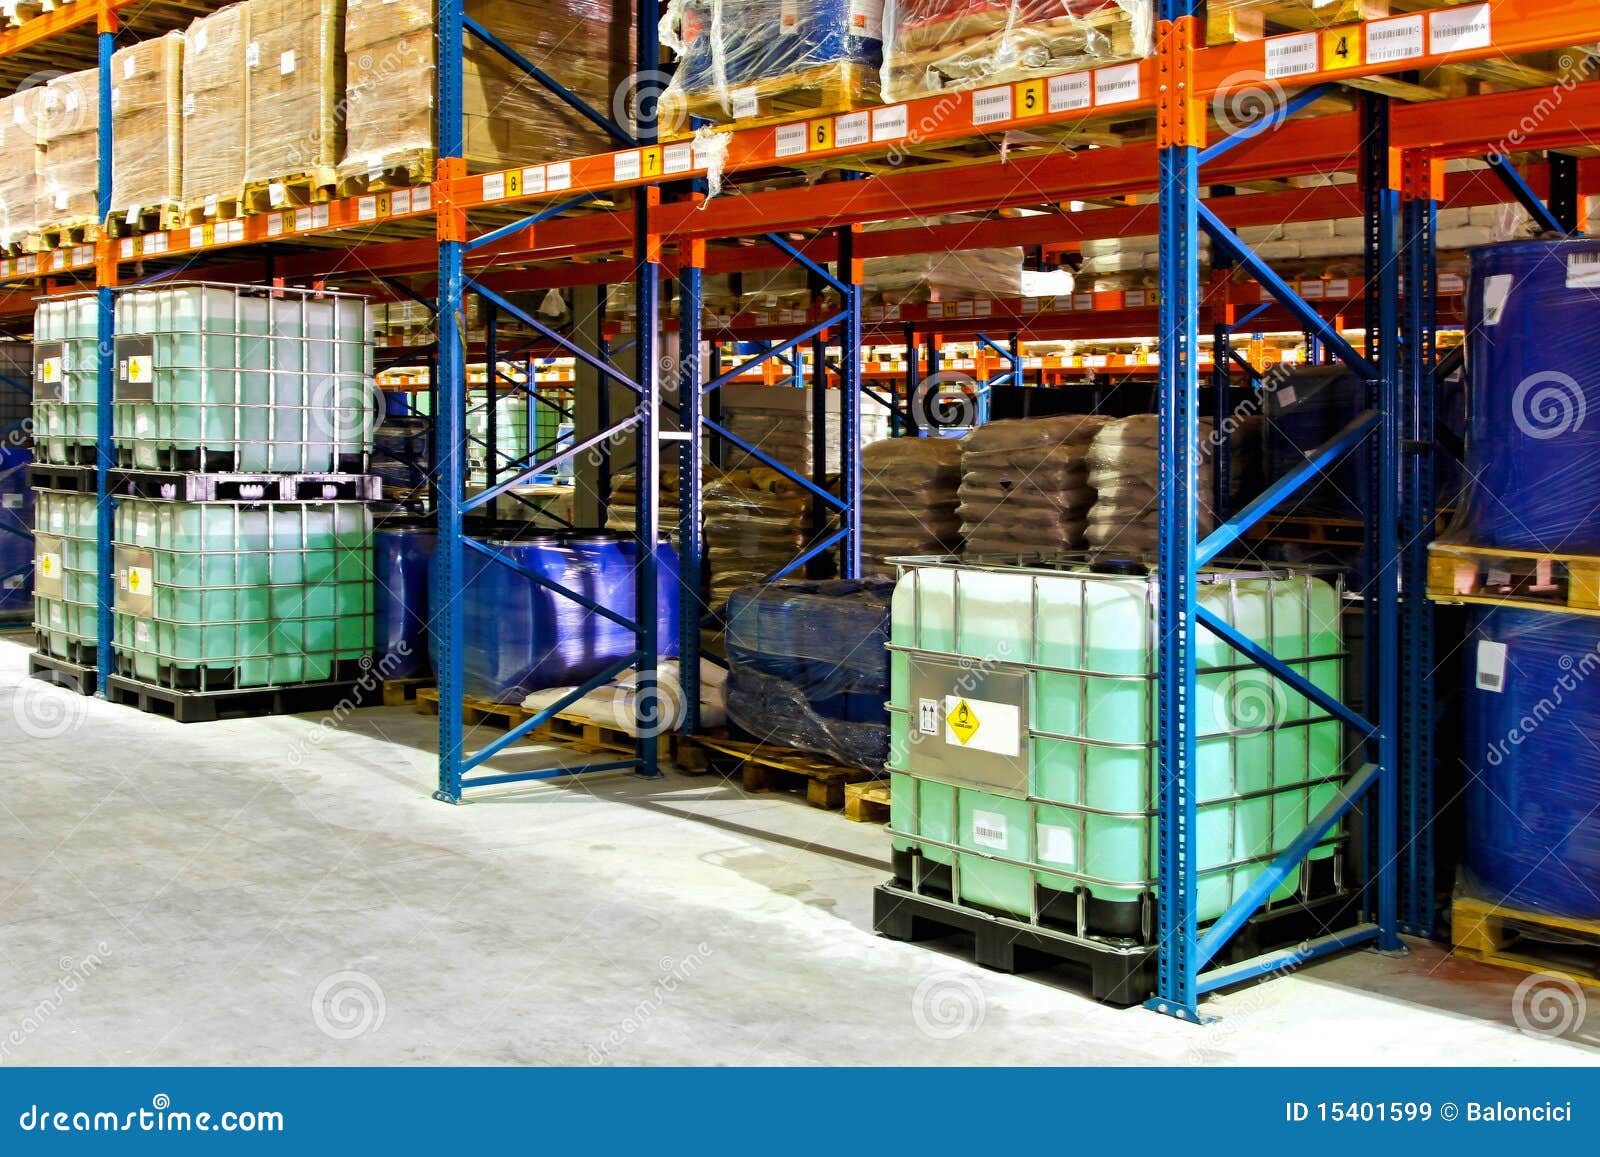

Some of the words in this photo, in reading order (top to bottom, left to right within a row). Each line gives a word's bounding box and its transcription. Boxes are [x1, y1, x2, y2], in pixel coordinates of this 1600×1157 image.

[1335, 36, 1348, 59] 4
[1025, 88, 1036, 109] 5
[816, 125, 825, 143] 6
[648, 154, 655, 170] 7
[510, 176, 517, 191] 8
[380, 198, 386, 213] 9
[285, 215, 293, 229] 10
